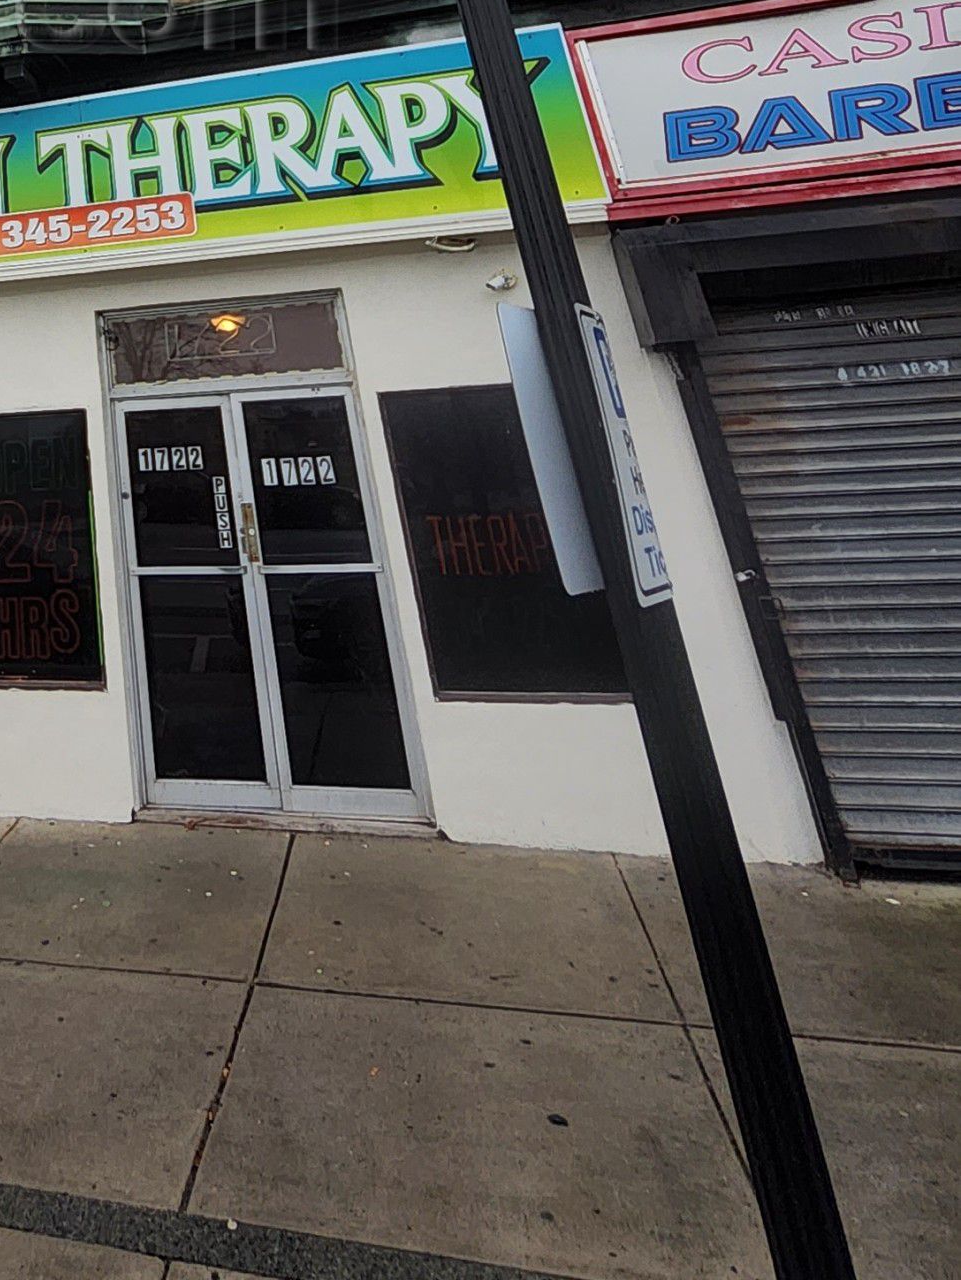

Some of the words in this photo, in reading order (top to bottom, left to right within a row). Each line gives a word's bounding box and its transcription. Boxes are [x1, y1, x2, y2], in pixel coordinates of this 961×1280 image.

[681, 1, 961, 84] CASI
[37, 62, 546, 210] THERAPY
[0, 200, 186, 249] 345-2253
[140, 447, 202, 470] 1722
[263, 457, 335, 485] 1722
[214, 477, 232, 548] PUSH
